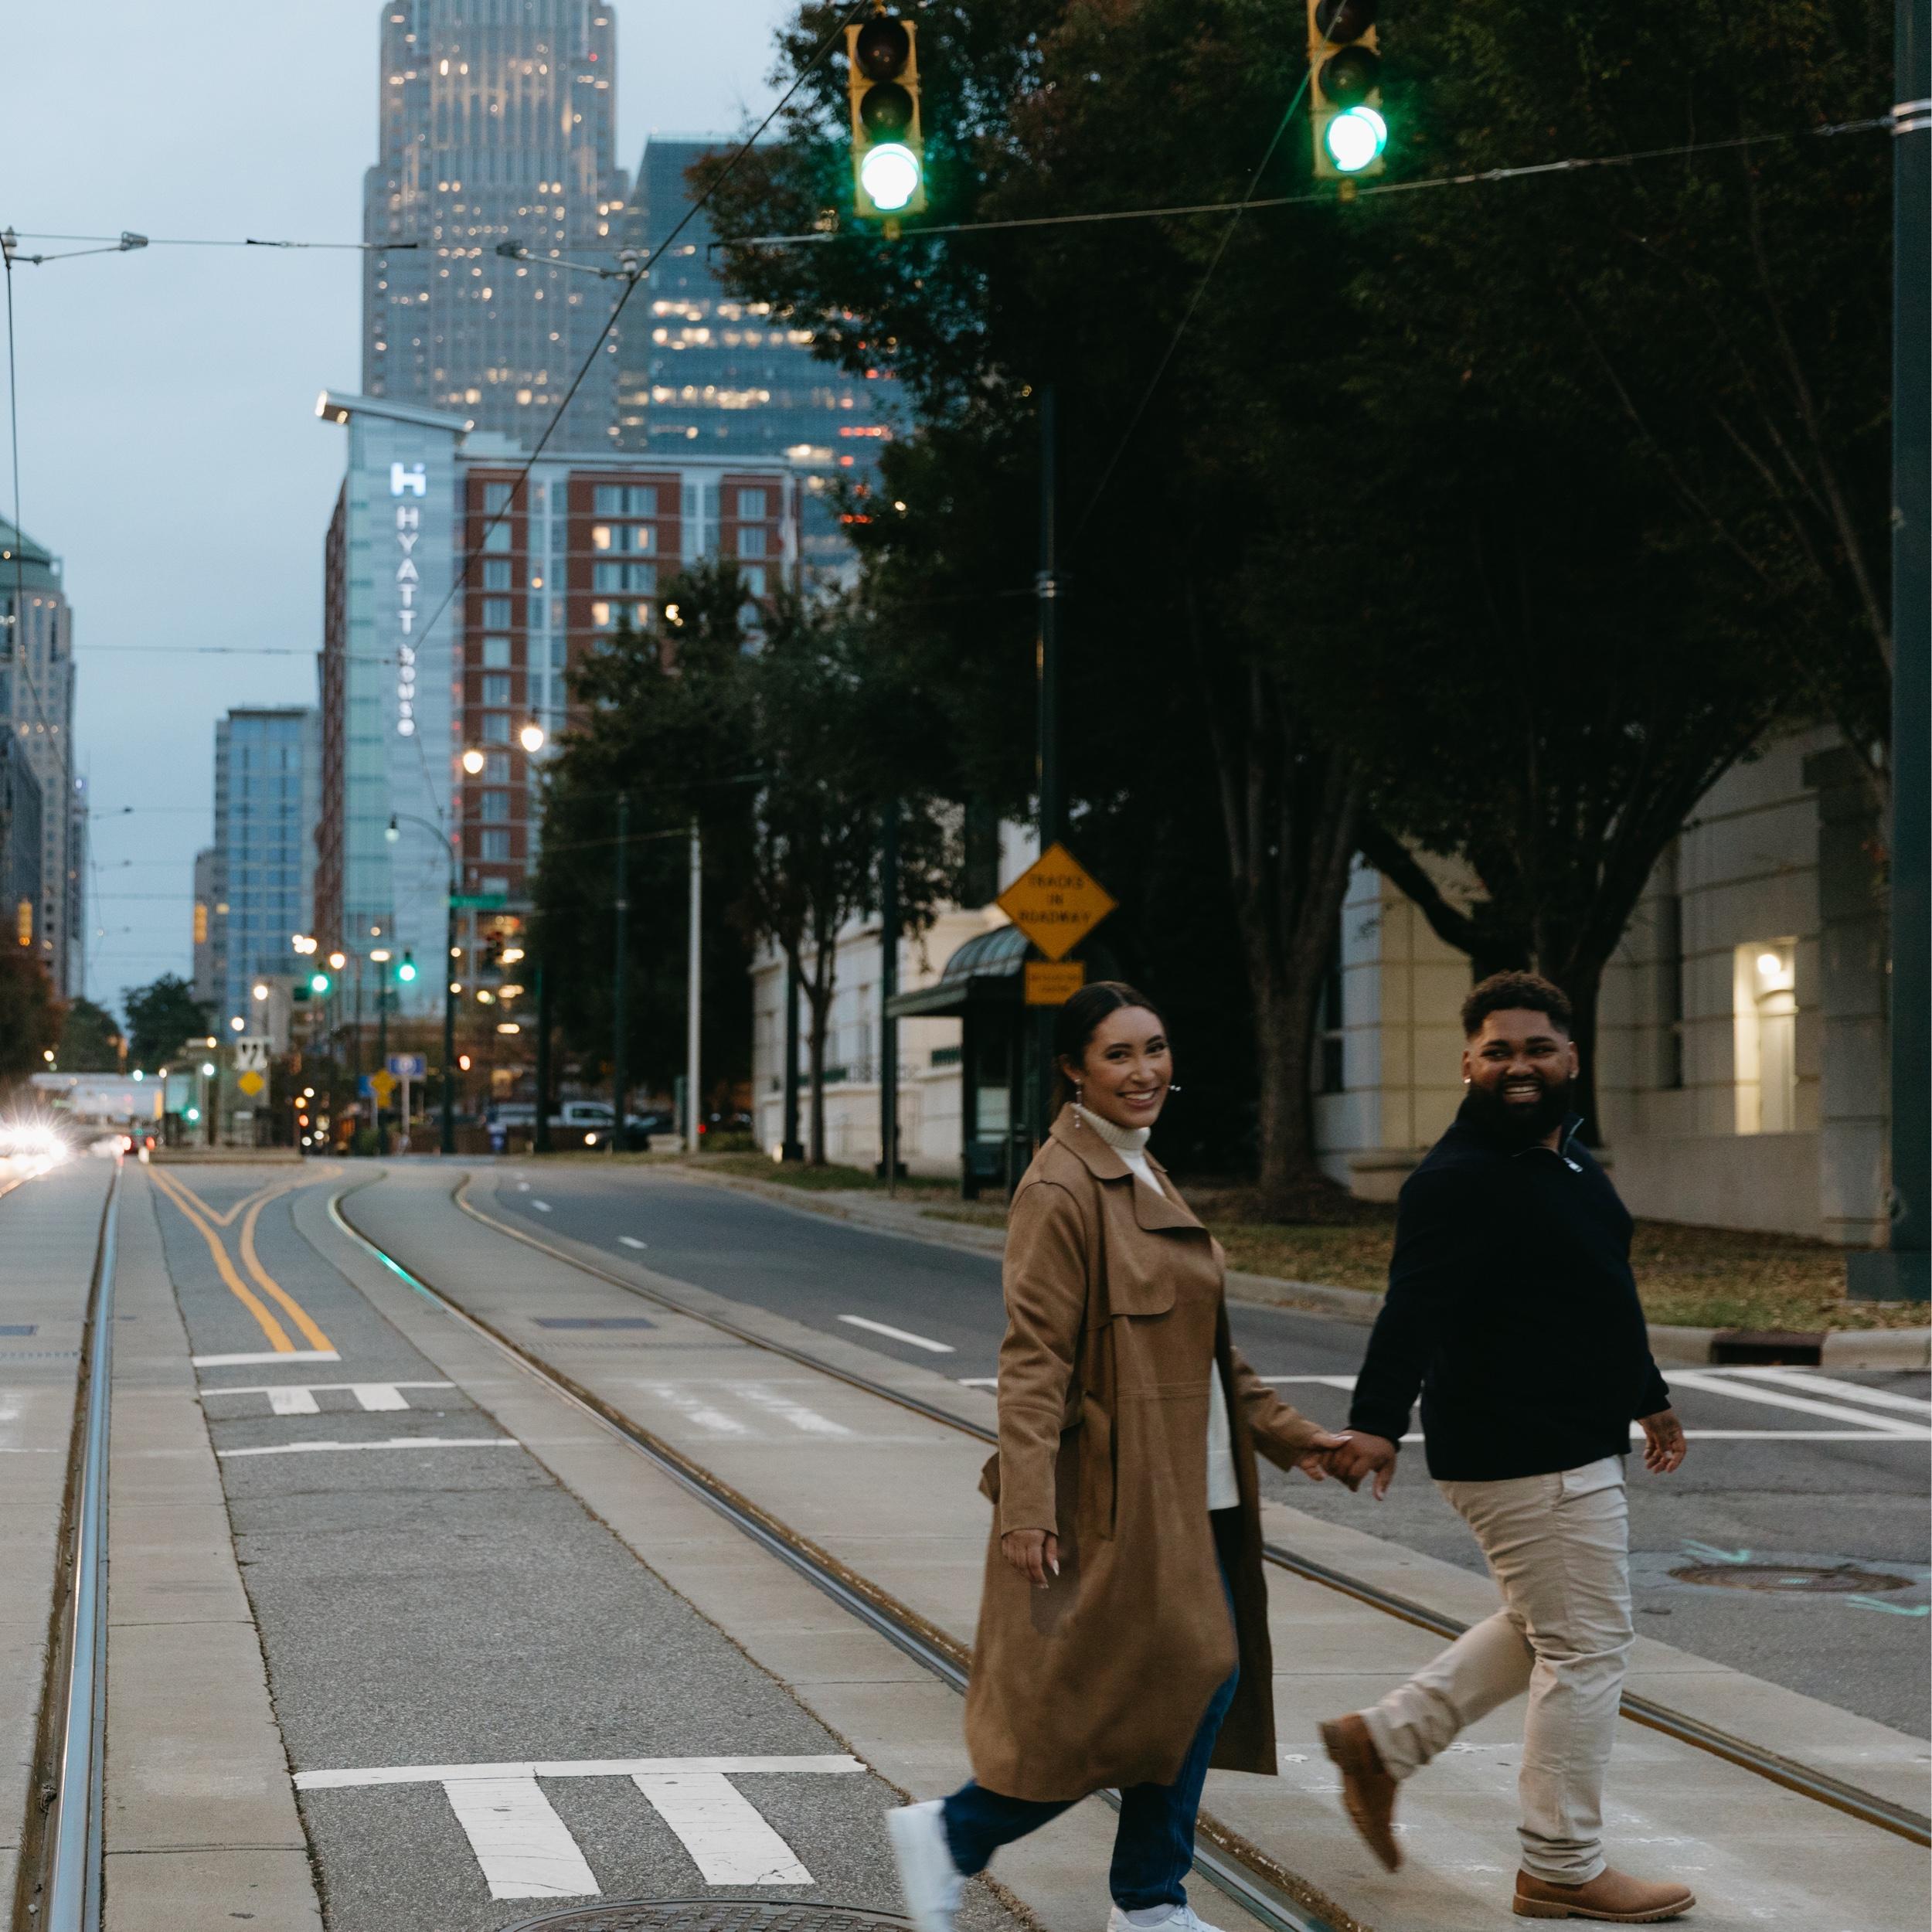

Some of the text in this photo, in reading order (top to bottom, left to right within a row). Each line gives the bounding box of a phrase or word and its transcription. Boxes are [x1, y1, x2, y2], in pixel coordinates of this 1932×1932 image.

[396, 505, 419, 635] HYATT
[1029, 874, 1084, 888] TRACKS
[1049, 893, 1064, 905] IN
[1019, 910, 1091, 923] ROADWAY
